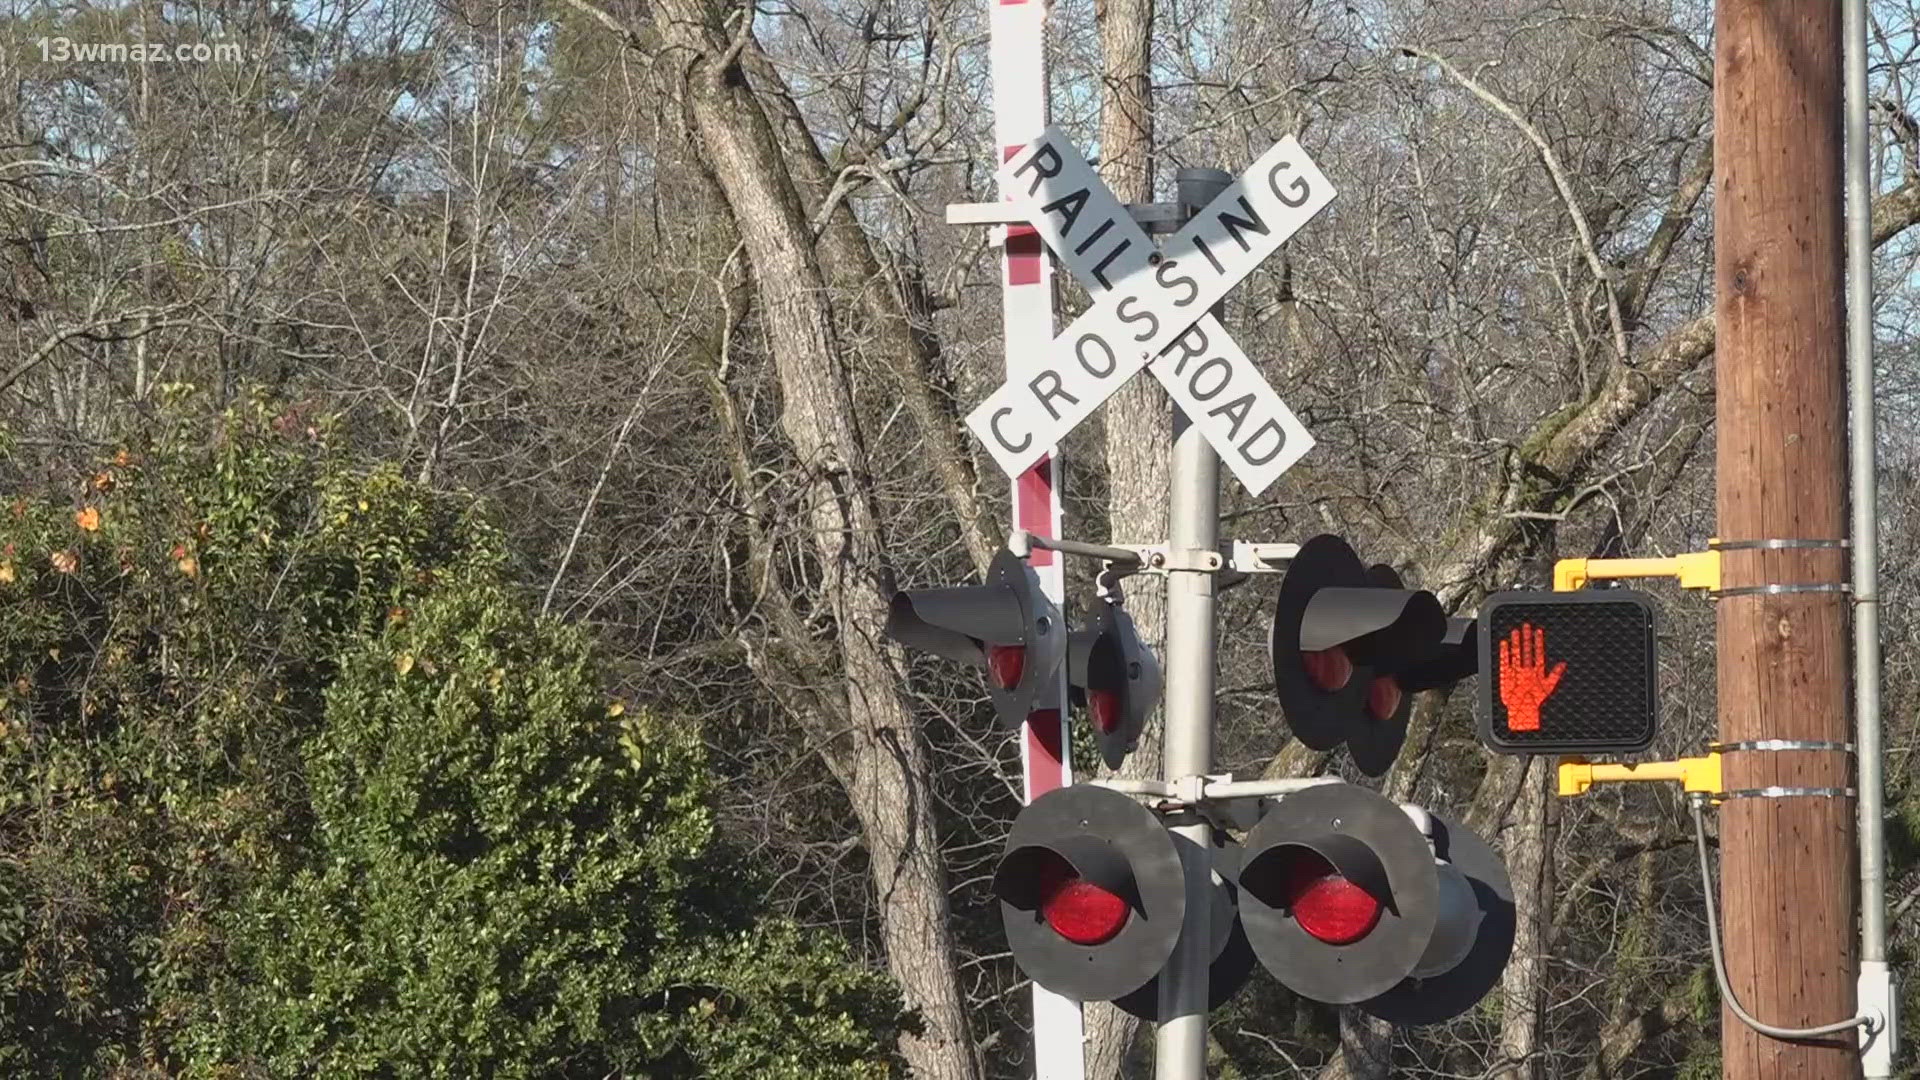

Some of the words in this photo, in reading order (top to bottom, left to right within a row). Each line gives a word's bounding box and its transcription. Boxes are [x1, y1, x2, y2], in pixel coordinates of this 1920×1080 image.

[990, 161, 1311, 454] CROSSING
[1013, 142, 1132, 292] RAIL
[1158, 322, 1287, 466] ROAD
